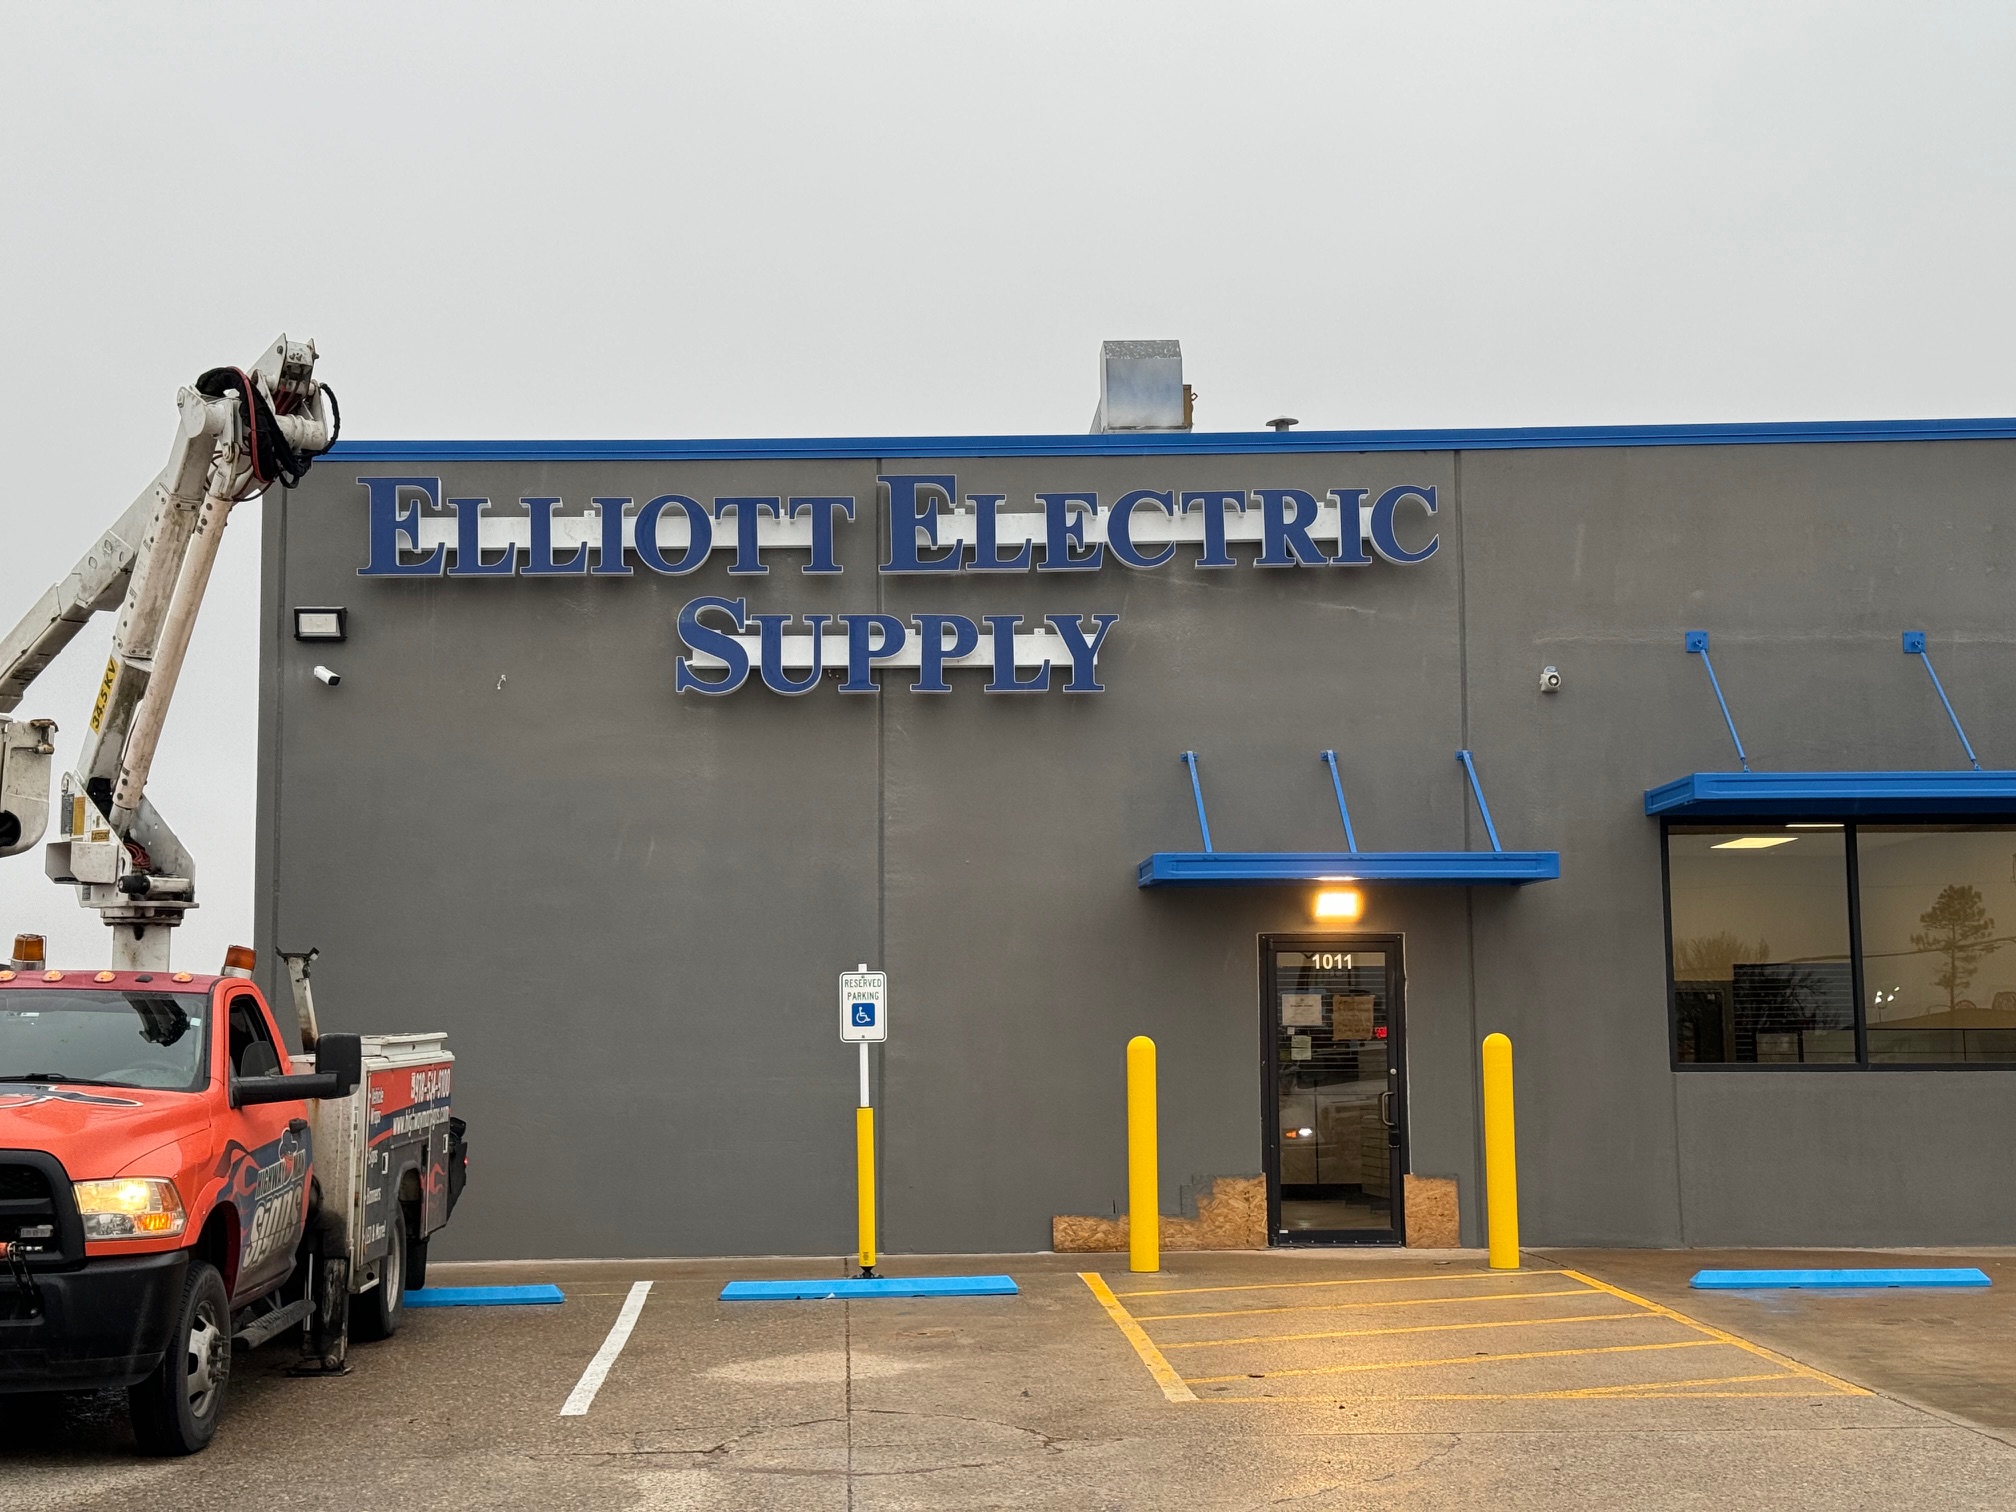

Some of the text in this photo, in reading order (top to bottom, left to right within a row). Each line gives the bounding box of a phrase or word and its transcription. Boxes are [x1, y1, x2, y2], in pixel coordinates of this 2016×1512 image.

[356, 473, 1440, 577] ELLIOTT ELECTRIC
[676, 595, 1120, 696] SUPPLY
[92, 660, 116, 729] 34.5 KV
[844, 978, 882, 988] RESERVED
[1312, 953, 1352, 970] 1011
[847, 991, 880, 1001] PARKING
